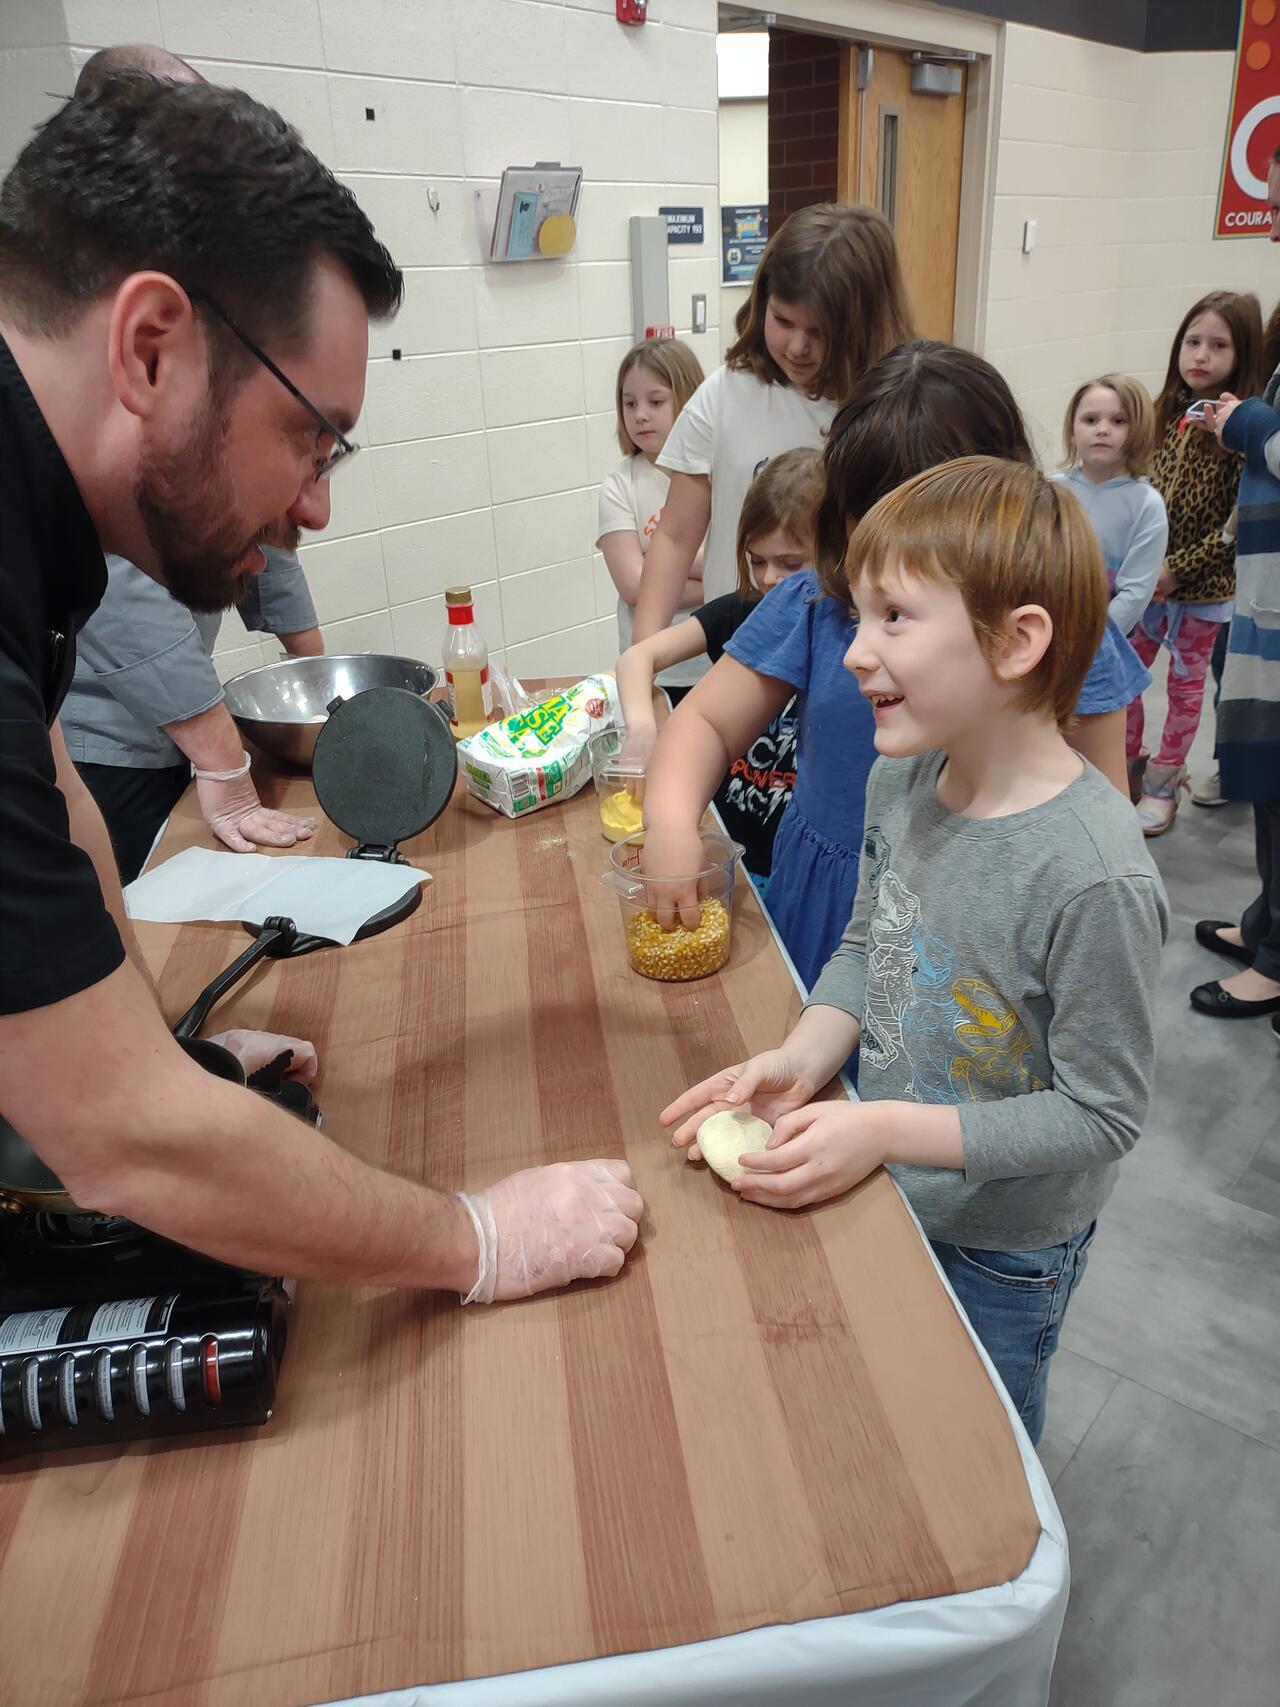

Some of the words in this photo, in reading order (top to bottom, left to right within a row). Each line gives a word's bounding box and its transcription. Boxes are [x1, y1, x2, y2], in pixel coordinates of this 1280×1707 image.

[667, 214, 695, 223] MAXIMUM
[1224, 211, 1273, 227] COURA
[667, 224, 691, 233] APACITY
